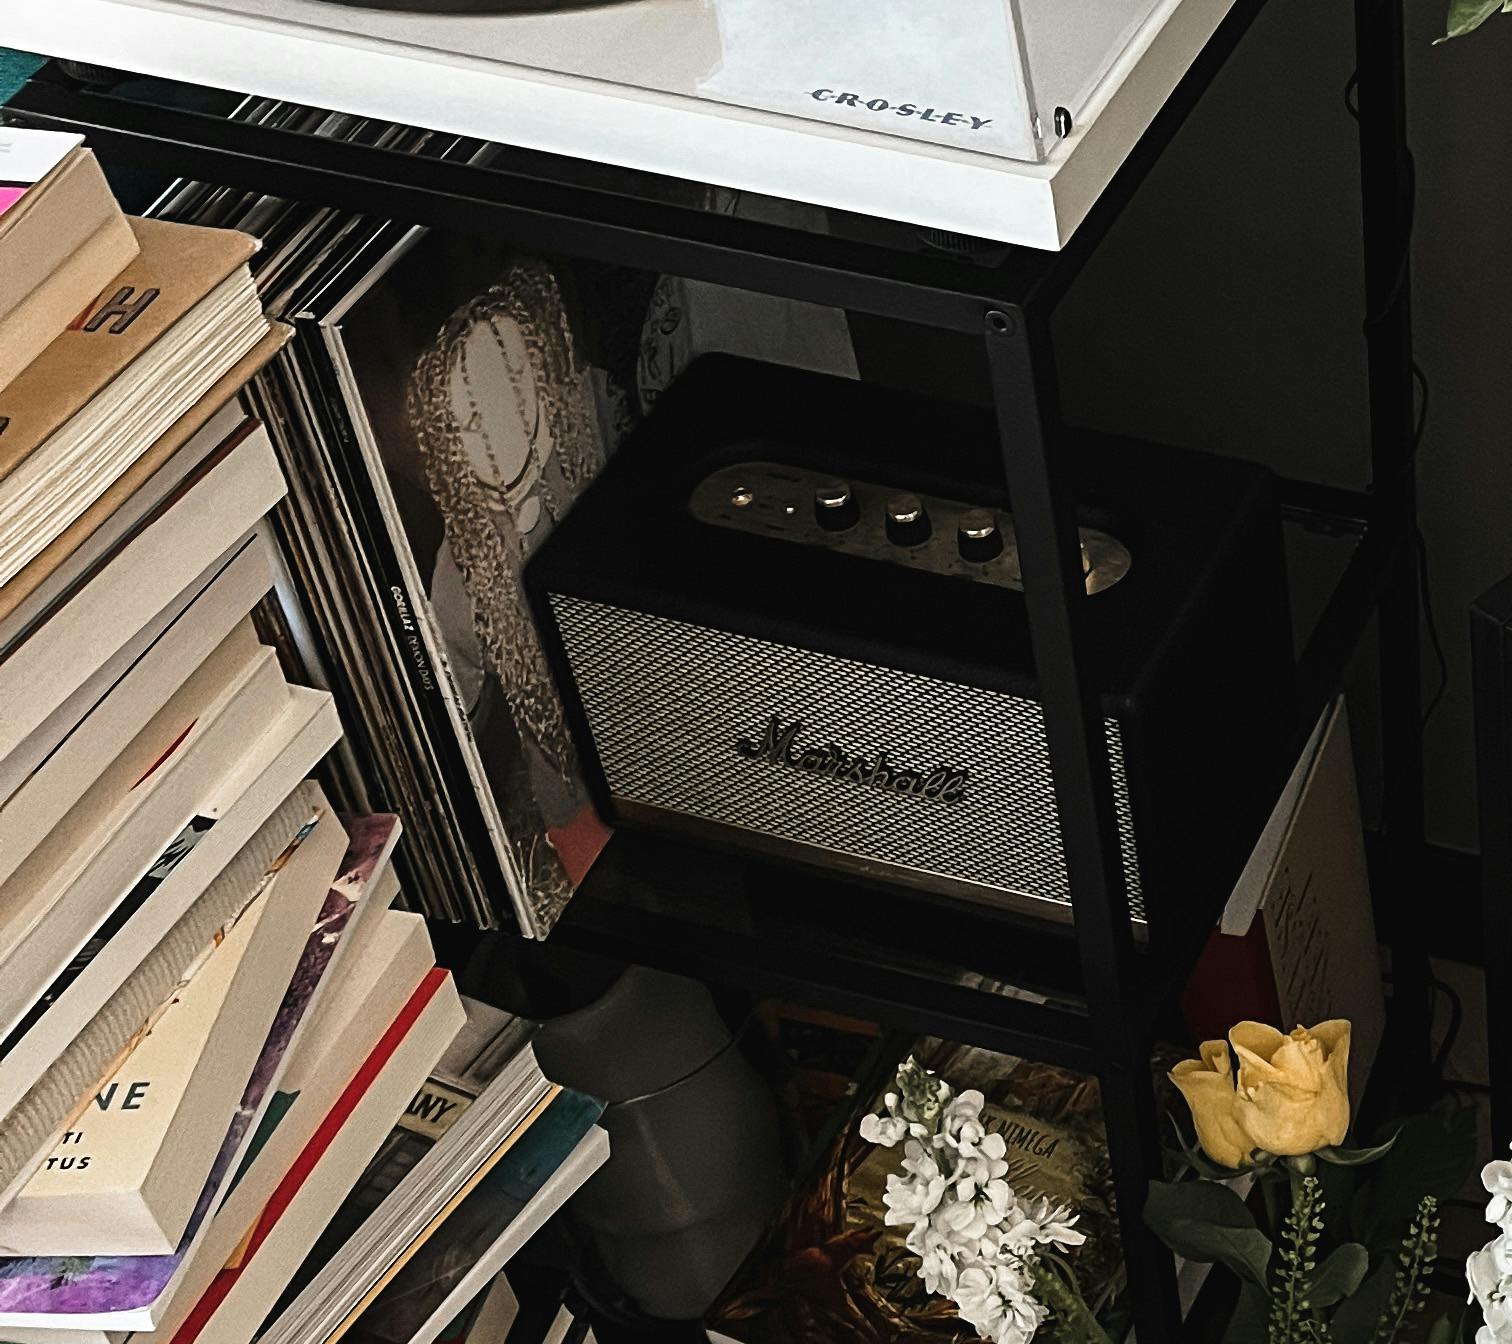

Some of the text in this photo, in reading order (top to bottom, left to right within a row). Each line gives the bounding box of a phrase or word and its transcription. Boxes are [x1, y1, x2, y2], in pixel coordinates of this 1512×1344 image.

[806, 88, 994, 130] CROSLEY
[80, 286, 161, 336] H
[390, 585, 414, 632] GORILLAZ
[738, 717, 964, 804] Marshall
[94, 1081, 151, 1111] NE
[62, 1131, 84, 1145] TI
[997, 1119, 1060, 1159] NIMEGA
[46, 1156, 91, 1170] TUS
